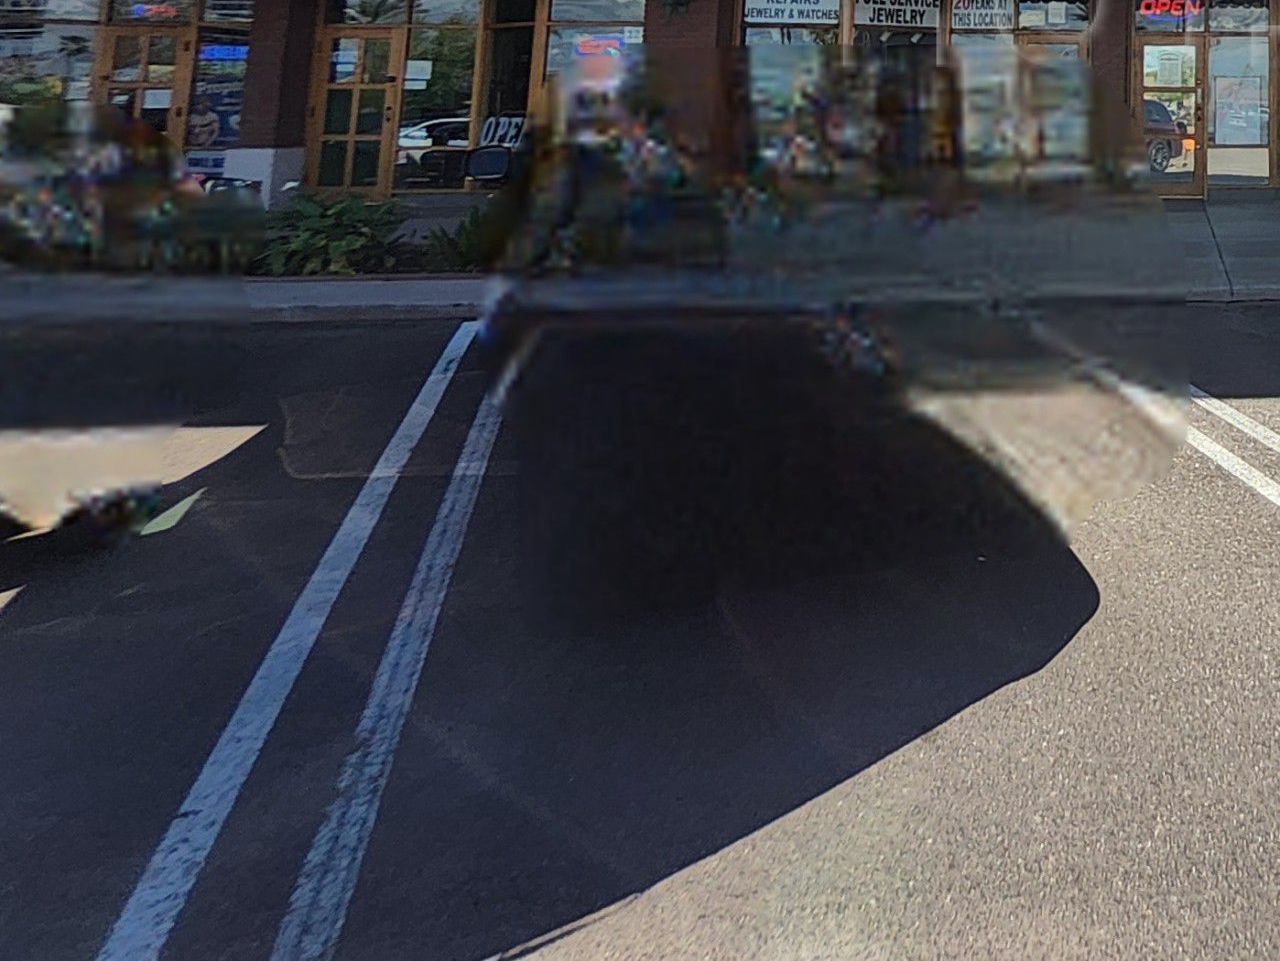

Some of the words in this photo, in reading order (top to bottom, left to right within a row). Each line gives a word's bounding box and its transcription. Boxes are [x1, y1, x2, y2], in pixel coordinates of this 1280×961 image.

[744, 7, 785, 18] JEWELRY
[788, 8, 795, 19] &
[797, 8, 840, 20] WATCHES
[869, 7, 926, 24] JEWELRY
[953, 12, 975, 27] THIS
[977, 13, 1013, 27] LOCATION
[480, 116, 524, 146] OPE
